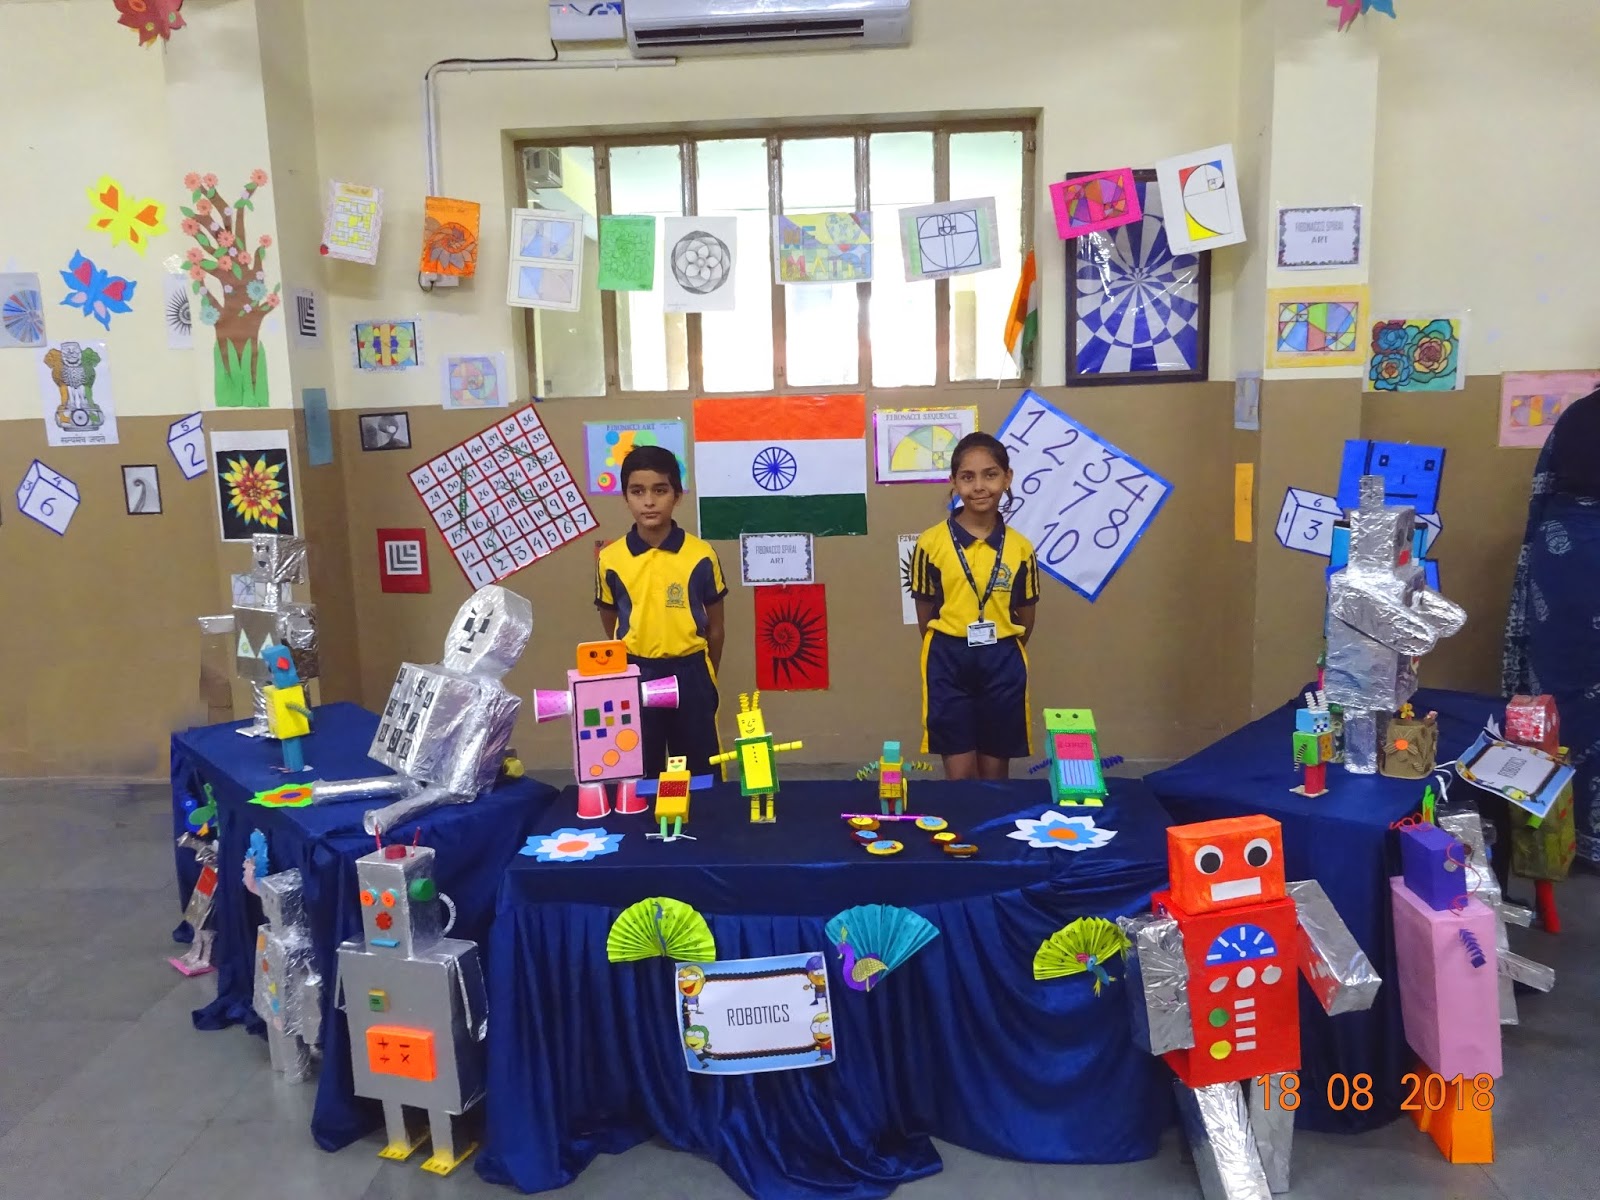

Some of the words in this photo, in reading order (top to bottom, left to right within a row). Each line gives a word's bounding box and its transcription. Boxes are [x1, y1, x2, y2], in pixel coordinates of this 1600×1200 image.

[885, 413, 920, 421] FIBONACCI
[922, 412, 958, 420] SEQUENCE
[183, 442, 205, 467] 2
[437, 462, 449, 474] 42
[471, 444, 483, 455] 40
[522, 413, 534, 426] 36
[446, 480, 459, 493] 30
[482, 459, 494, 472] 32
[532, 432, 545, 444] 35
[1009, 410, 1046, 446] 1
[1042, 428, 1079, 466] 2
[1082, 448, 1120, 484] 3
[1115, 473, 1149, 513] 4
[40, 497, 57, 517] 6
[441, 509, 454, 523] 28
[478, 489, 490, 501] 26
[508, 469, 522, 481] 24
[553, 470, 566, 483] 21
[451, 532, 463, 544] 15
[471, 518, 484, 531] 16
[490, 505, 500, 519] 17
[506, 497, 518, 510] 18
[537, 480, 549, 492] 20
[1021, 468, 1053, 495] 6
[1058, 481, 1098, 516] 7
[1093, 508, 1129, 549] 8
[1313, 498, 1323, 508] 6
[462, 549, 475, 564] 14
[502, 525, 516, 540] 12
[518, 517, 530, 529] 11
[533, 509, 545, 521] 10
[549, 498, 561, 510] 9
[566, 490, 576, 503] 8
[514, 545, 527, 561] 3
[533, 537, 543, 549] 4
[547, 529, 557, 542] 5
[563, 521, 572, 534] 6
[577, 512, 587, 525] 7
[781, 544, 797, 554] SPIRAL
[1035, 522, 1080, 565] 10
[1303, 519, 1323, 541] 3
[727, 1004, 790, 1026] ROBOTICS
